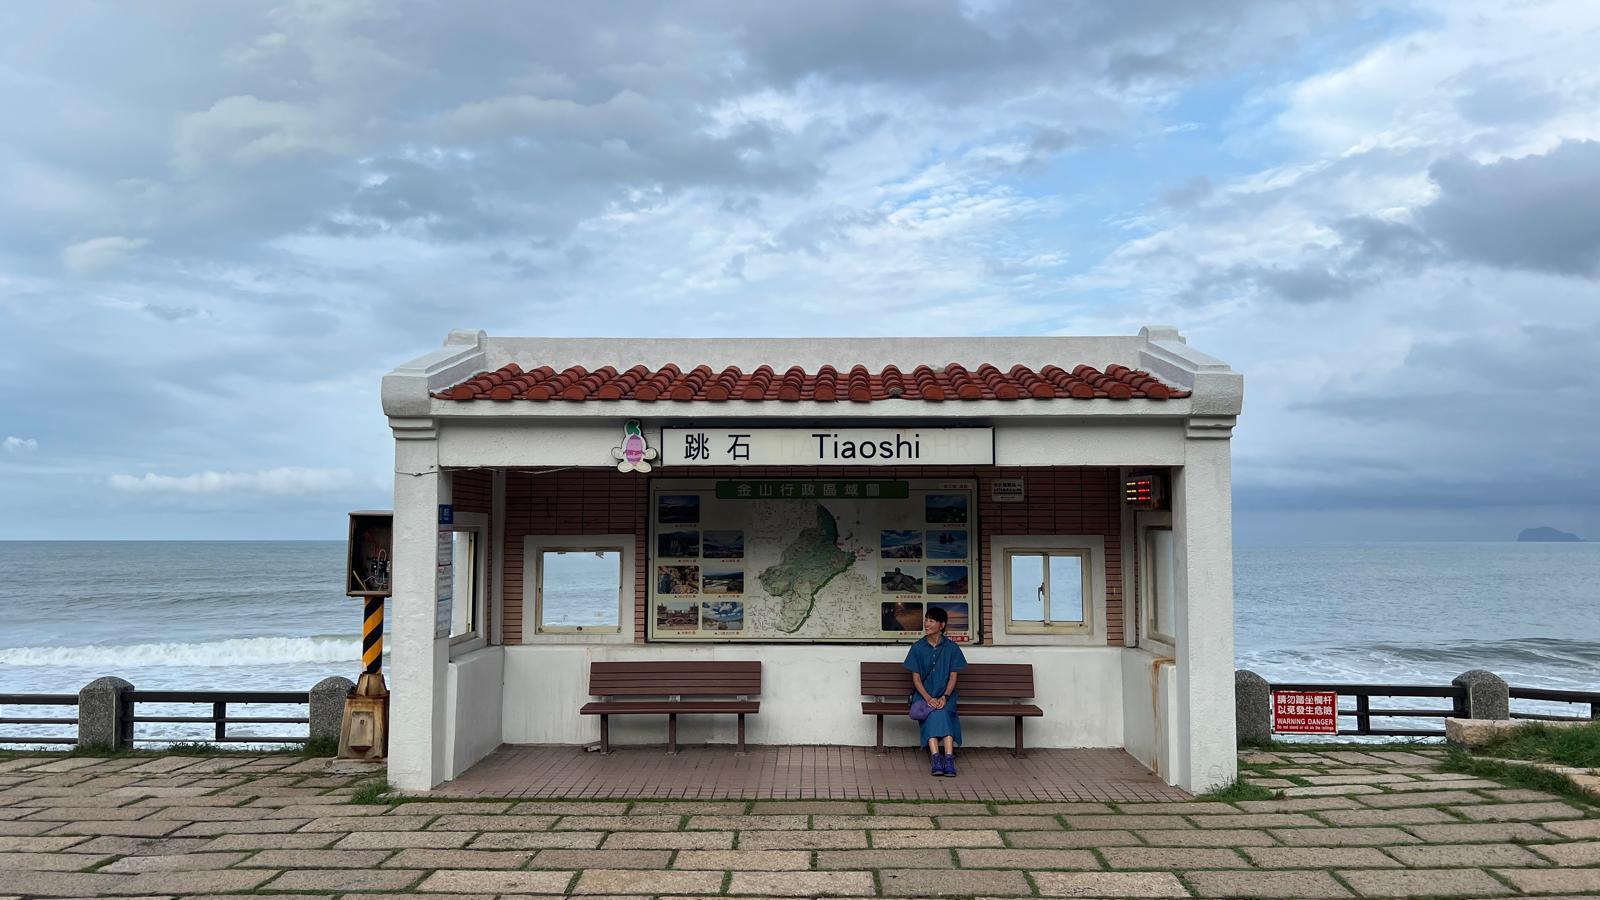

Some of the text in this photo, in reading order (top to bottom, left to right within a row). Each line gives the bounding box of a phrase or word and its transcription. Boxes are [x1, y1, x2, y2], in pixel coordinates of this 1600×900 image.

[683, 433, 752, 461] 跳石
[811, 433, 920, 459] Tiaoshi
[736, 483, 880, 497] 金山行政區域圖
[1278, 705, 1332, 715] 以免發生危險
